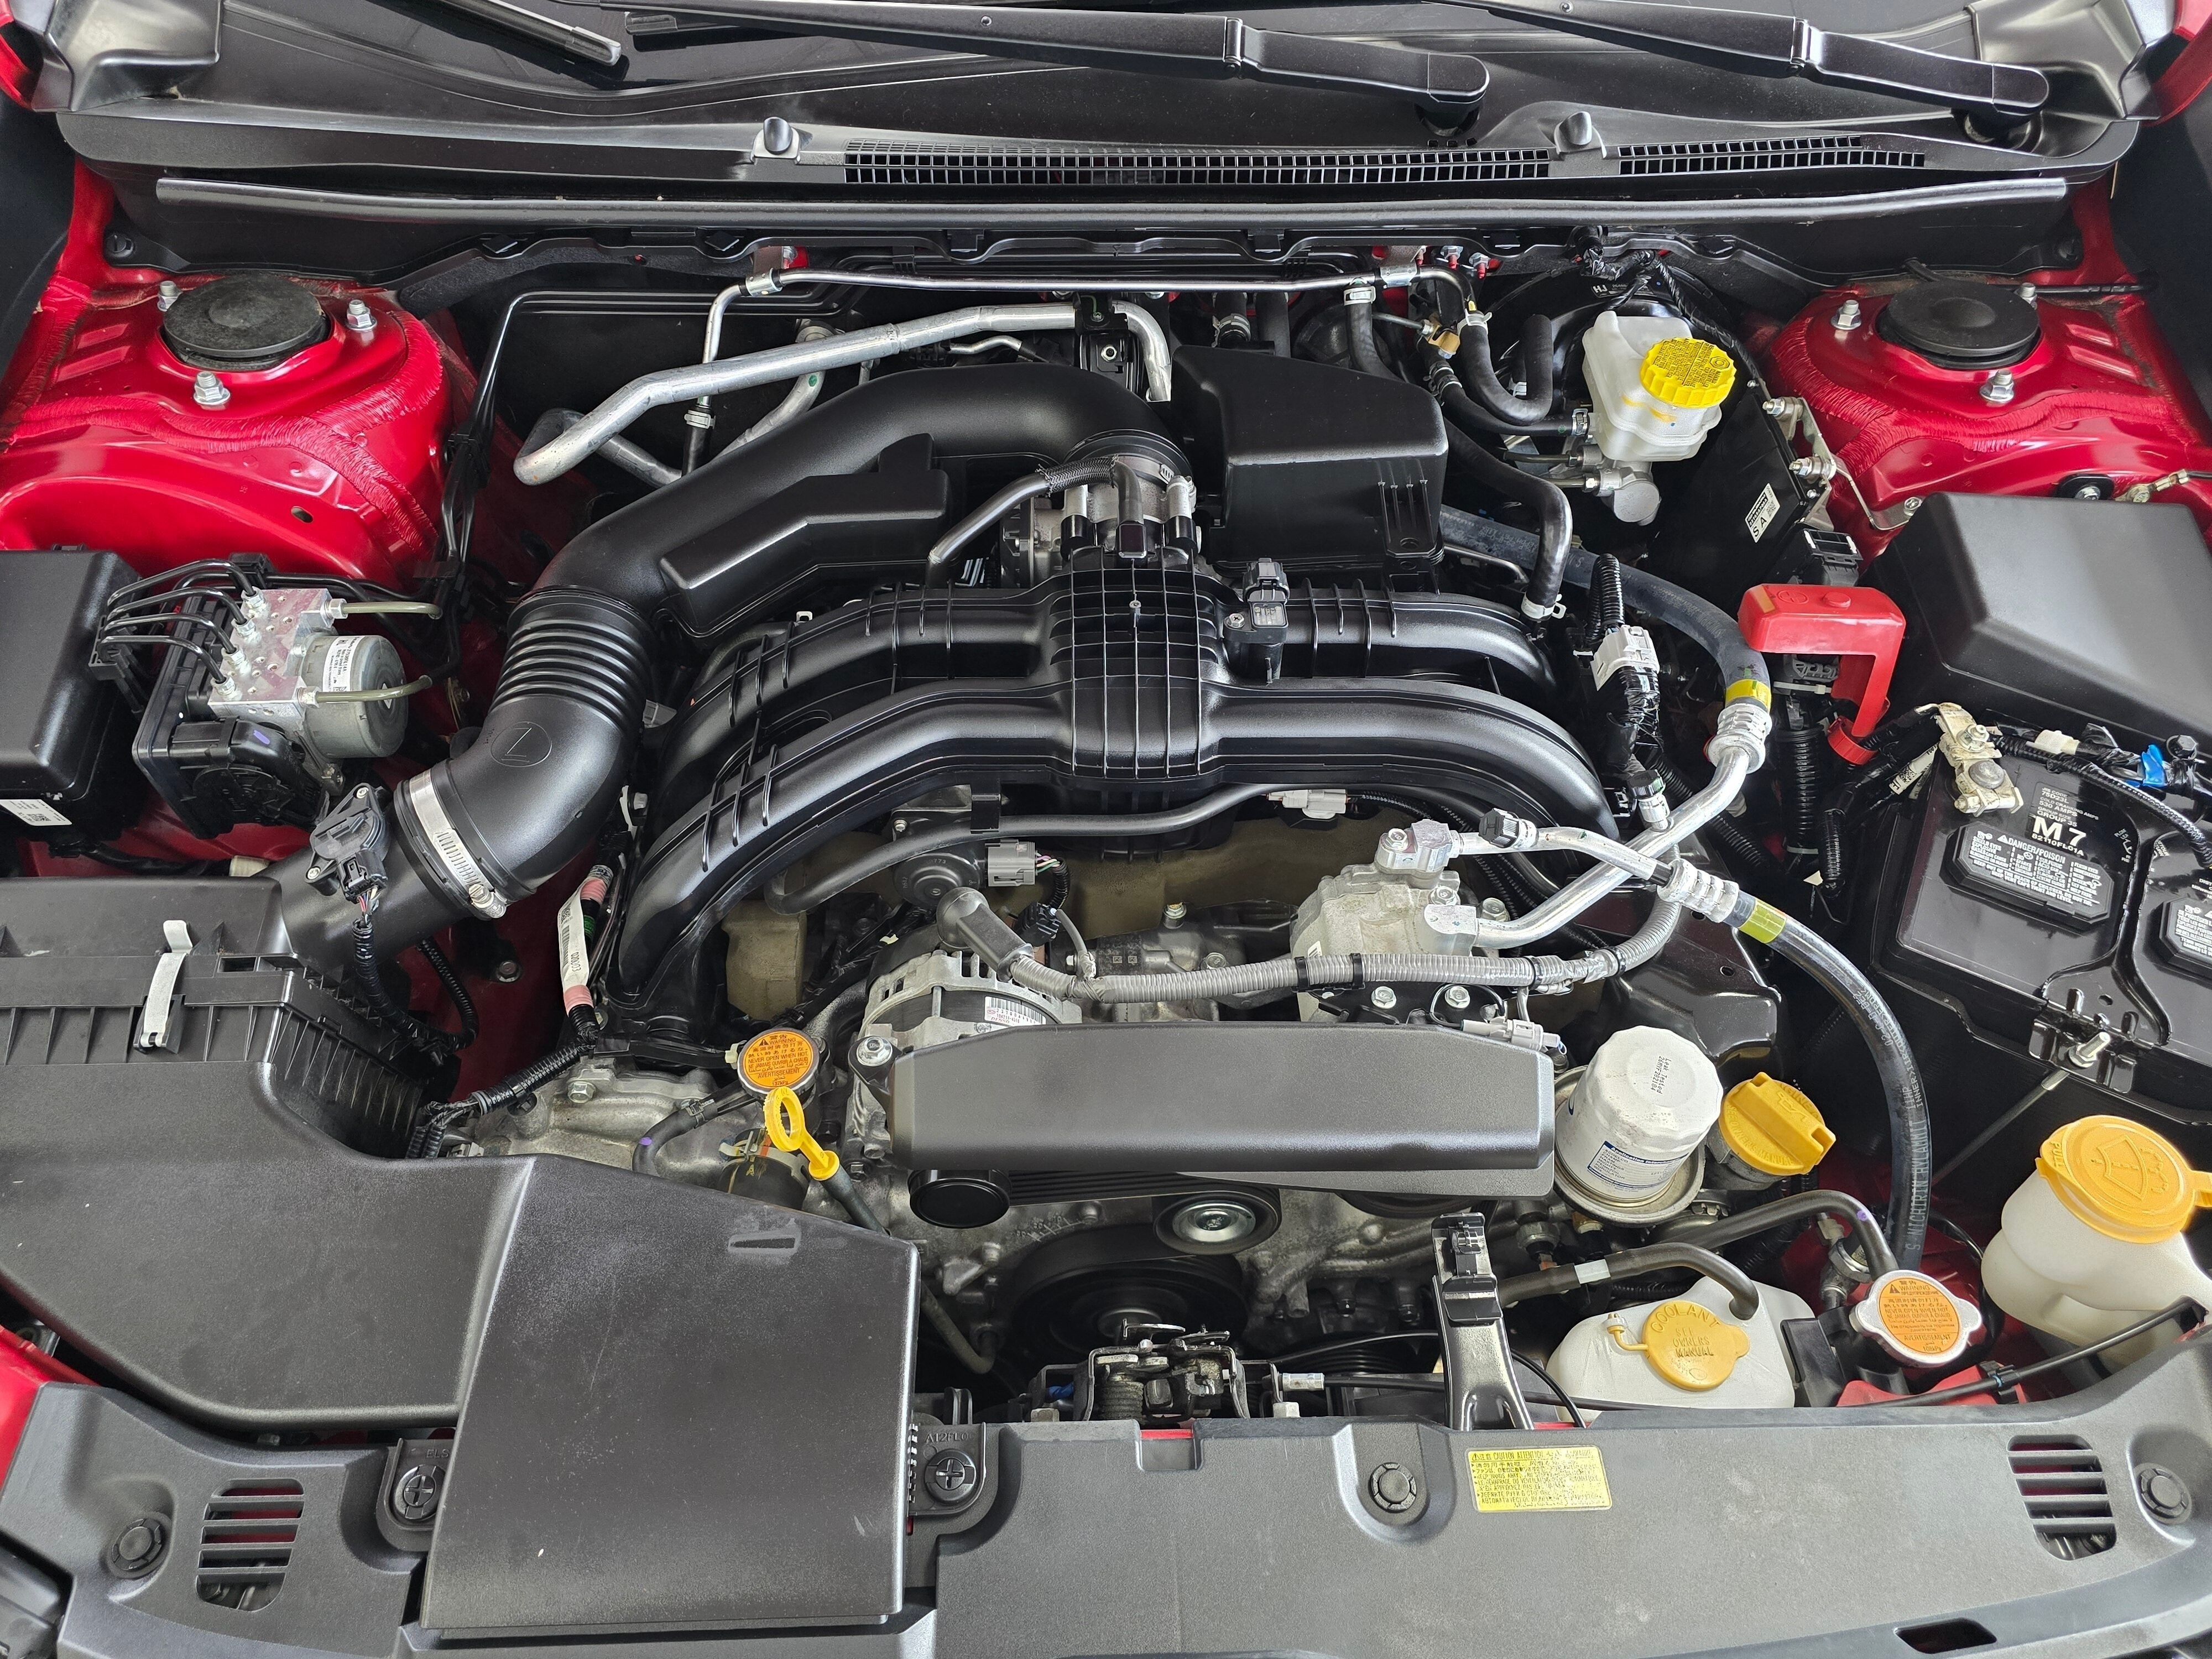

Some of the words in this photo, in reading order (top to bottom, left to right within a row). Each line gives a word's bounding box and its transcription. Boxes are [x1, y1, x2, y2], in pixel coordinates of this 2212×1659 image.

[2041, 789, 2070, 805] 75D23L
[2037, 805, 2058, 816] GROUP
[2038, 800, 2053, 809] 530
[2054, 804, 2078, 818] AMPS
[2039, 796, 2055, 805] COLD
[2055, 801, 2083, 815] CRANKING
[2083, 811, 2099, 821] AMPS
[2036, 809, 2066, 825] GROUP
[2067, 820, 2078, 828] 35
[2032, 816, 2063, 842] M
[2068, 827, 2086, 847] 7
[2007, 837, 2066, 864] DANGER/POISON
[758, 1068, 800, 1079] AVERTISSEMENT
[1656, 1073, 1666, 1094] Tested
[1601, 1154, 1615, 1164] FRAM
[1604, 1149, 1629, 1163] ACDELCO
[1611, 1147, 1645, 1164] Application
[1757, 1147, 1794, 1166] MANUAL
[2049, 1141, 2065, 1168] PULL
[1595, 1163, 1625, 1180] PUROLATOR
[1598, 1159, 1616, 1170] MIGHTY
[1599, 1156, 1625, 1171] HASTINGS
[1907, 1180, 1928, 1235] NICHIRIN
[1650, 1303, 1720, 1333] COOLANT
[1673, 1336, 1710, 1348] OWNERS
[1675, 1346, 1714, 1358] MANUAL
[1517, 1451, 1543, 1459] ATTENTION
